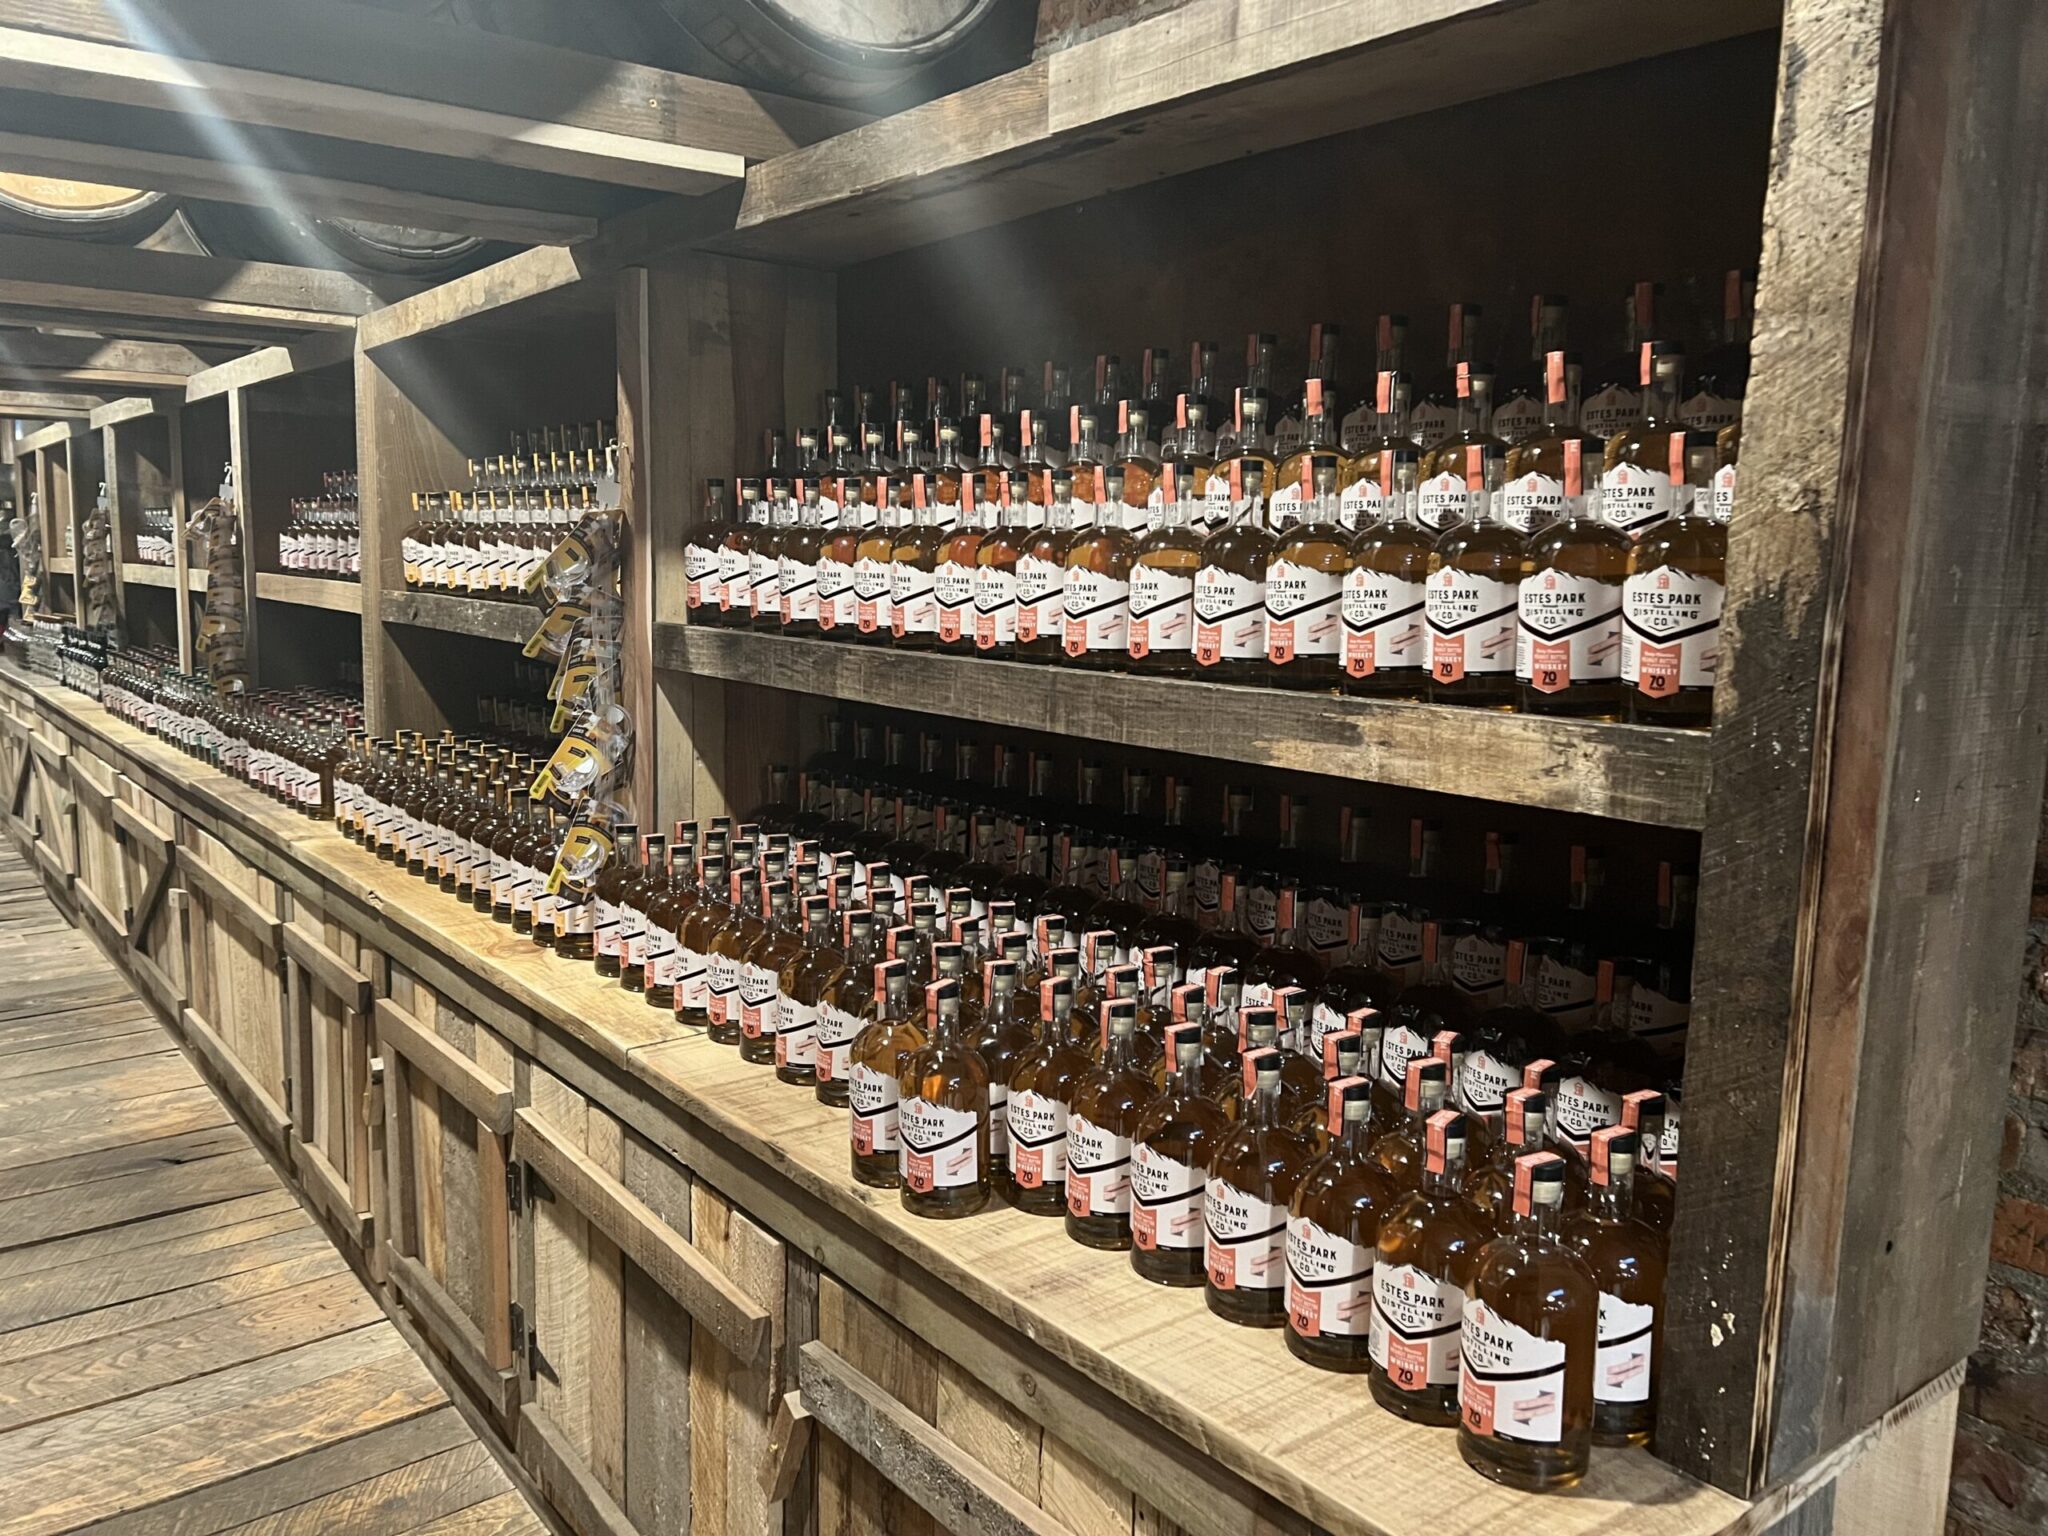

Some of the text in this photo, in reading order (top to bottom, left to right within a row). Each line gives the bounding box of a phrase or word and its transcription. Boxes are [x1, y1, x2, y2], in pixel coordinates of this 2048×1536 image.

[1603, 487, 1655, 497] STES PARK
[1423, 495, 1466, 503] ESTES PAR
[1507, 496, 1532, 505] ESTES
[1275, 503, 1296, 511] ESTES
[1344, 501, 1363, 509] ESTES
[953, 576, 970, 584] PARK
[1284, 581, 1307, 589] PARK
[1079, 584, 1098, 592] PARK
[1214, 587, 1235, 595] PARK
[1364, 589, 1388, 598] PARK
[1452, 590, 1479, 599] PARK
[1524, 593, 1586, 603] ESTES PARK
[1632, 592, 1701, 604] ESTES PARK
[1634, 608, 1698, 619] DISTILLING
[1202, 649, 1212, 658] 70
[1274, 647, 1285, 656] 70
[1354, 659, 1365, 668] 70
[1440, 663, 1453, 674] 70
[1542, 671, 1557, 682] 70
[1641, 667, 1677, 675] WHISKEY
[1649, 675, 1665, 687] 70
[827, 1018, 843, 1028] PARK
[1385, 1040, 1404, 1054] ESTES
[1484, 1074, 1508, 1087] PARK
[864, 1084, 883, 1093] PARK
[1559, 1092, 1610, 1114] STES PARK
[1011, 1104, 1055, 1120] ESTES PARK
[922, 1118, 944, 1127] PARK
[1082, 1137, 1103, 1149] PARK
[1022, 1171, 1033, 1181] 70
[1147, 1167, 1169, 1180] PARK
[914, 1176, 924, 1186] 70
[1224, 1204, 1248, 1218] PARK
[1139, 1230, 1147, 1242] 70
[1311, 1245, 1337, 1260] PARK
[1215, 1270, 1225, 1282] 70
[1381, 1279, 1445, 1308] ESTES PARK
[1381, 1296, 1442, 1322] DISTILLING
[1297, 1314, 1308, 1327] 70
[1484, 1331, 1513, 1352] PARK
[1390, 1356, 1424, 1372] WHISKEY
[1398, 1368, 1414, 1381] 70
[1469, 1408, 1481, 1425] 70
